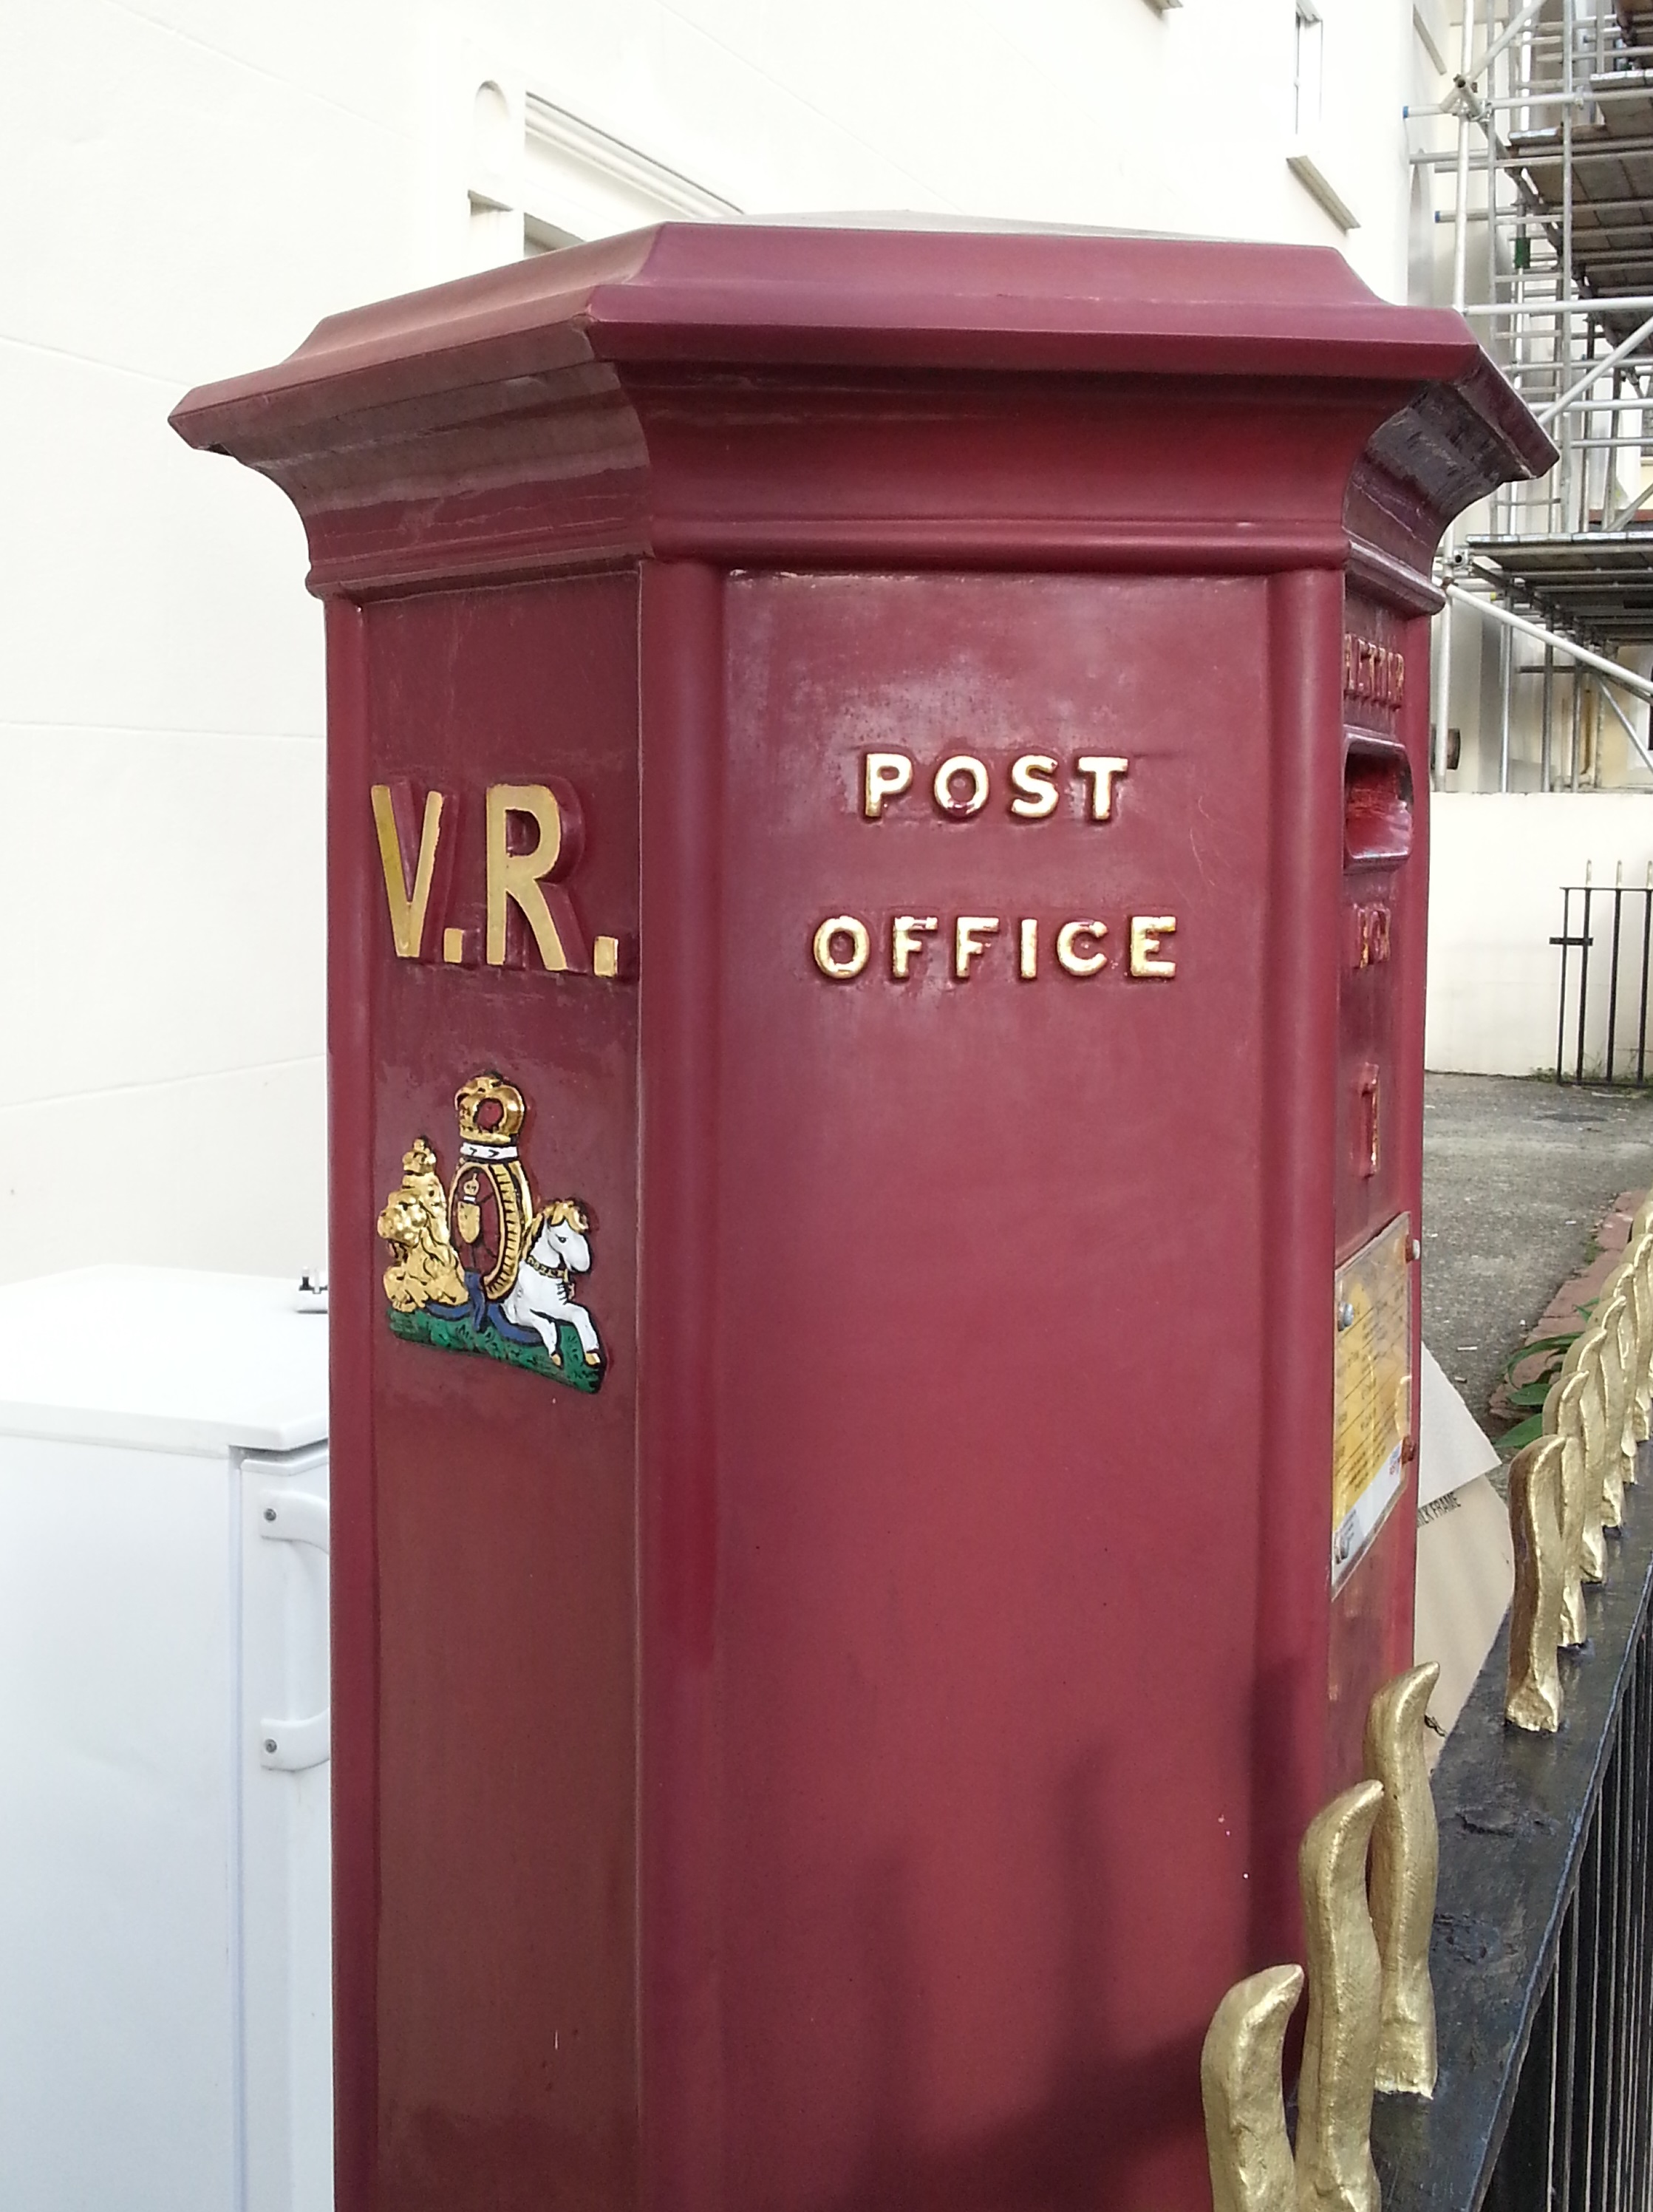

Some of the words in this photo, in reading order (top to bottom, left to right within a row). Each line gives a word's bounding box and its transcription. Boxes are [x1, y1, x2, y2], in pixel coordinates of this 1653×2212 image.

[864, 752, 1129, 822] POST
[370, 783, 619, 978] V.R.
[813, 914, 1177, 980] OFFICE
[1428, 1491, 1462, 1518] FRAME
